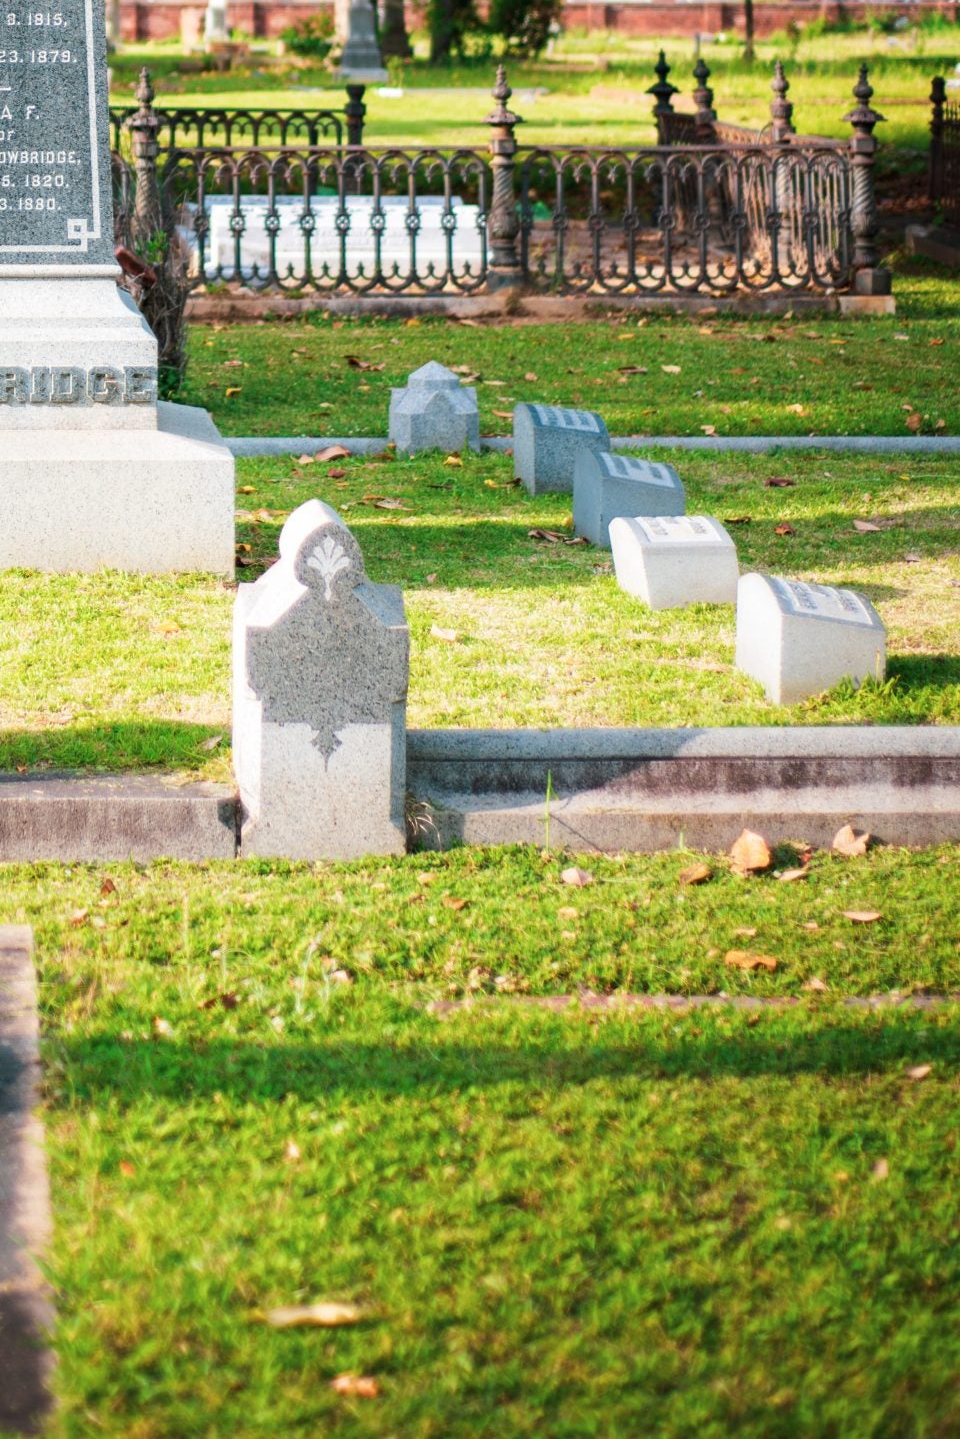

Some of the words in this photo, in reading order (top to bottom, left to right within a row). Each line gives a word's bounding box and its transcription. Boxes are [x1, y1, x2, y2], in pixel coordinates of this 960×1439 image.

[31, 50, 77, 63] 1879.
[25, 105, 41, 120] F.
[18, 198, 61, 210] 1880.
